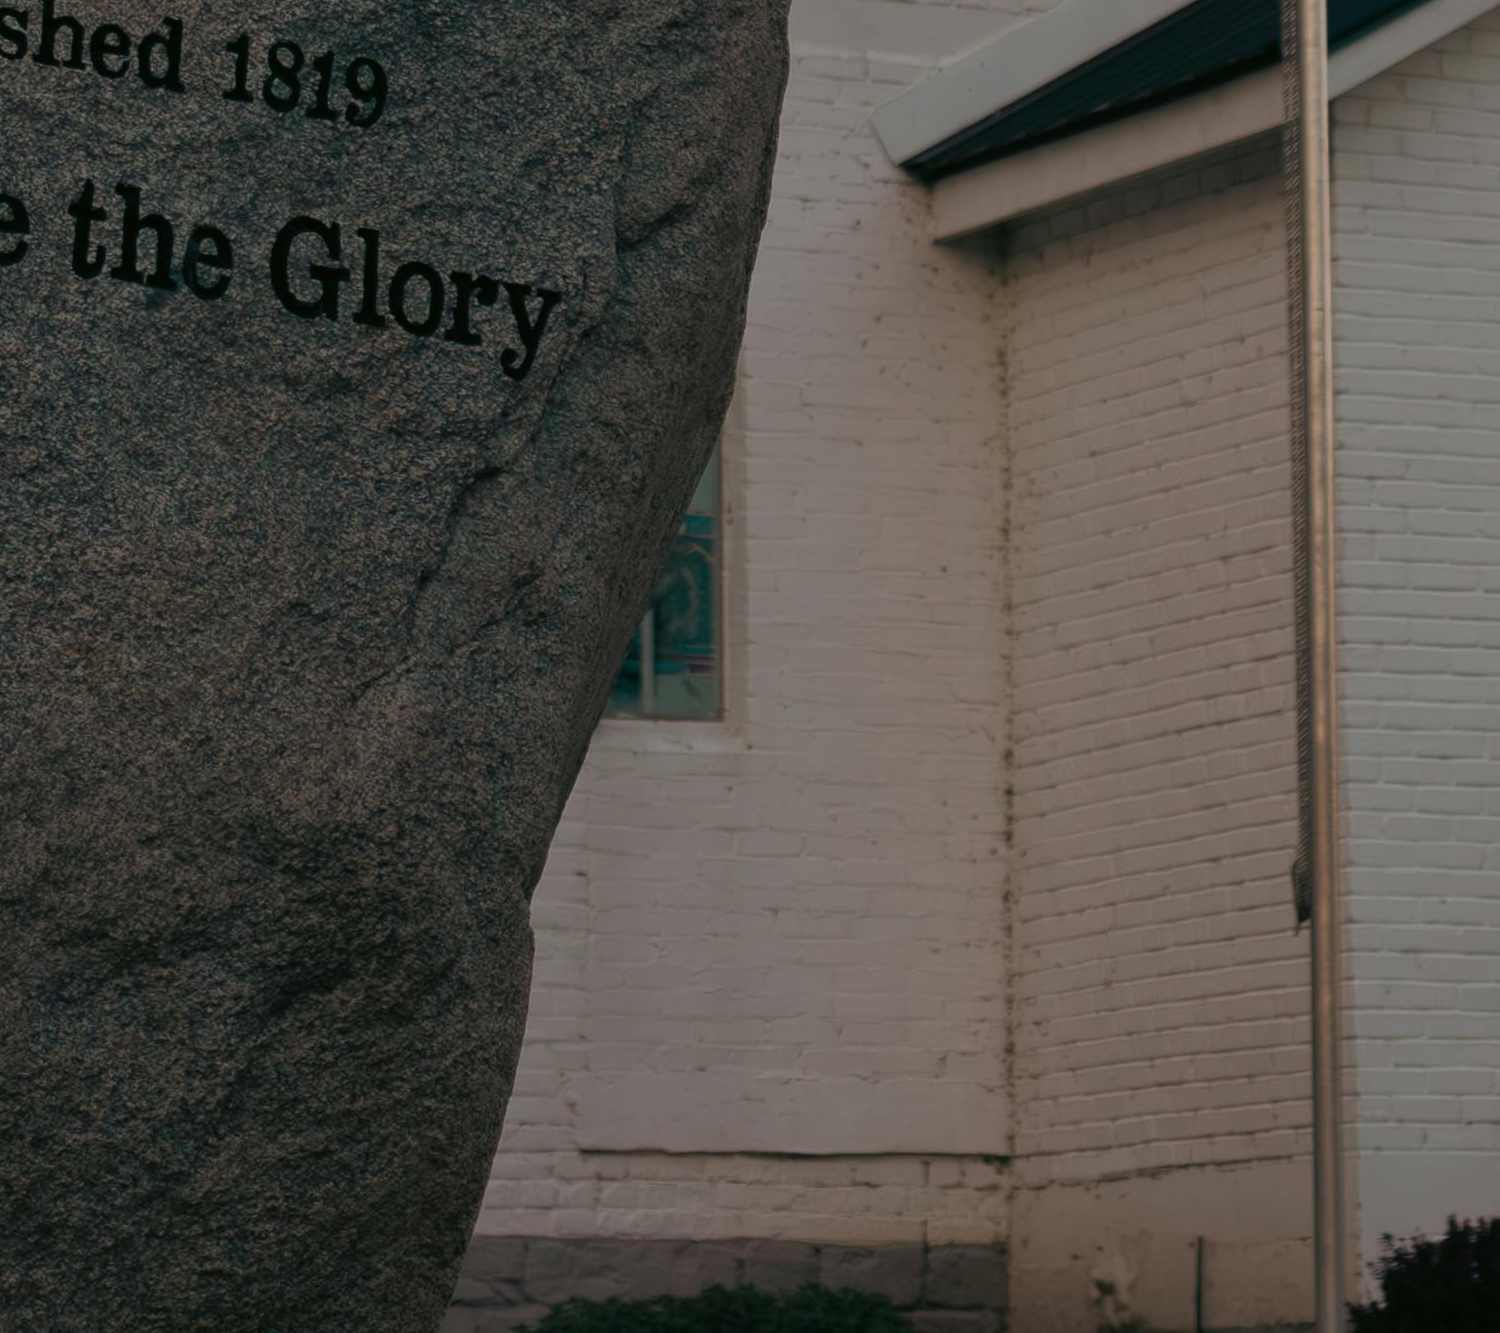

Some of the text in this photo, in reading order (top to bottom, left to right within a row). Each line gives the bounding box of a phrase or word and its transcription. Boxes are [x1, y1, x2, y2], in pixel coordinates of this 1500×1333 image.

[220, 31, 392, 132] 1819
[66, 179, 236, 305] the
[266, 213, 566, 383] Glory
